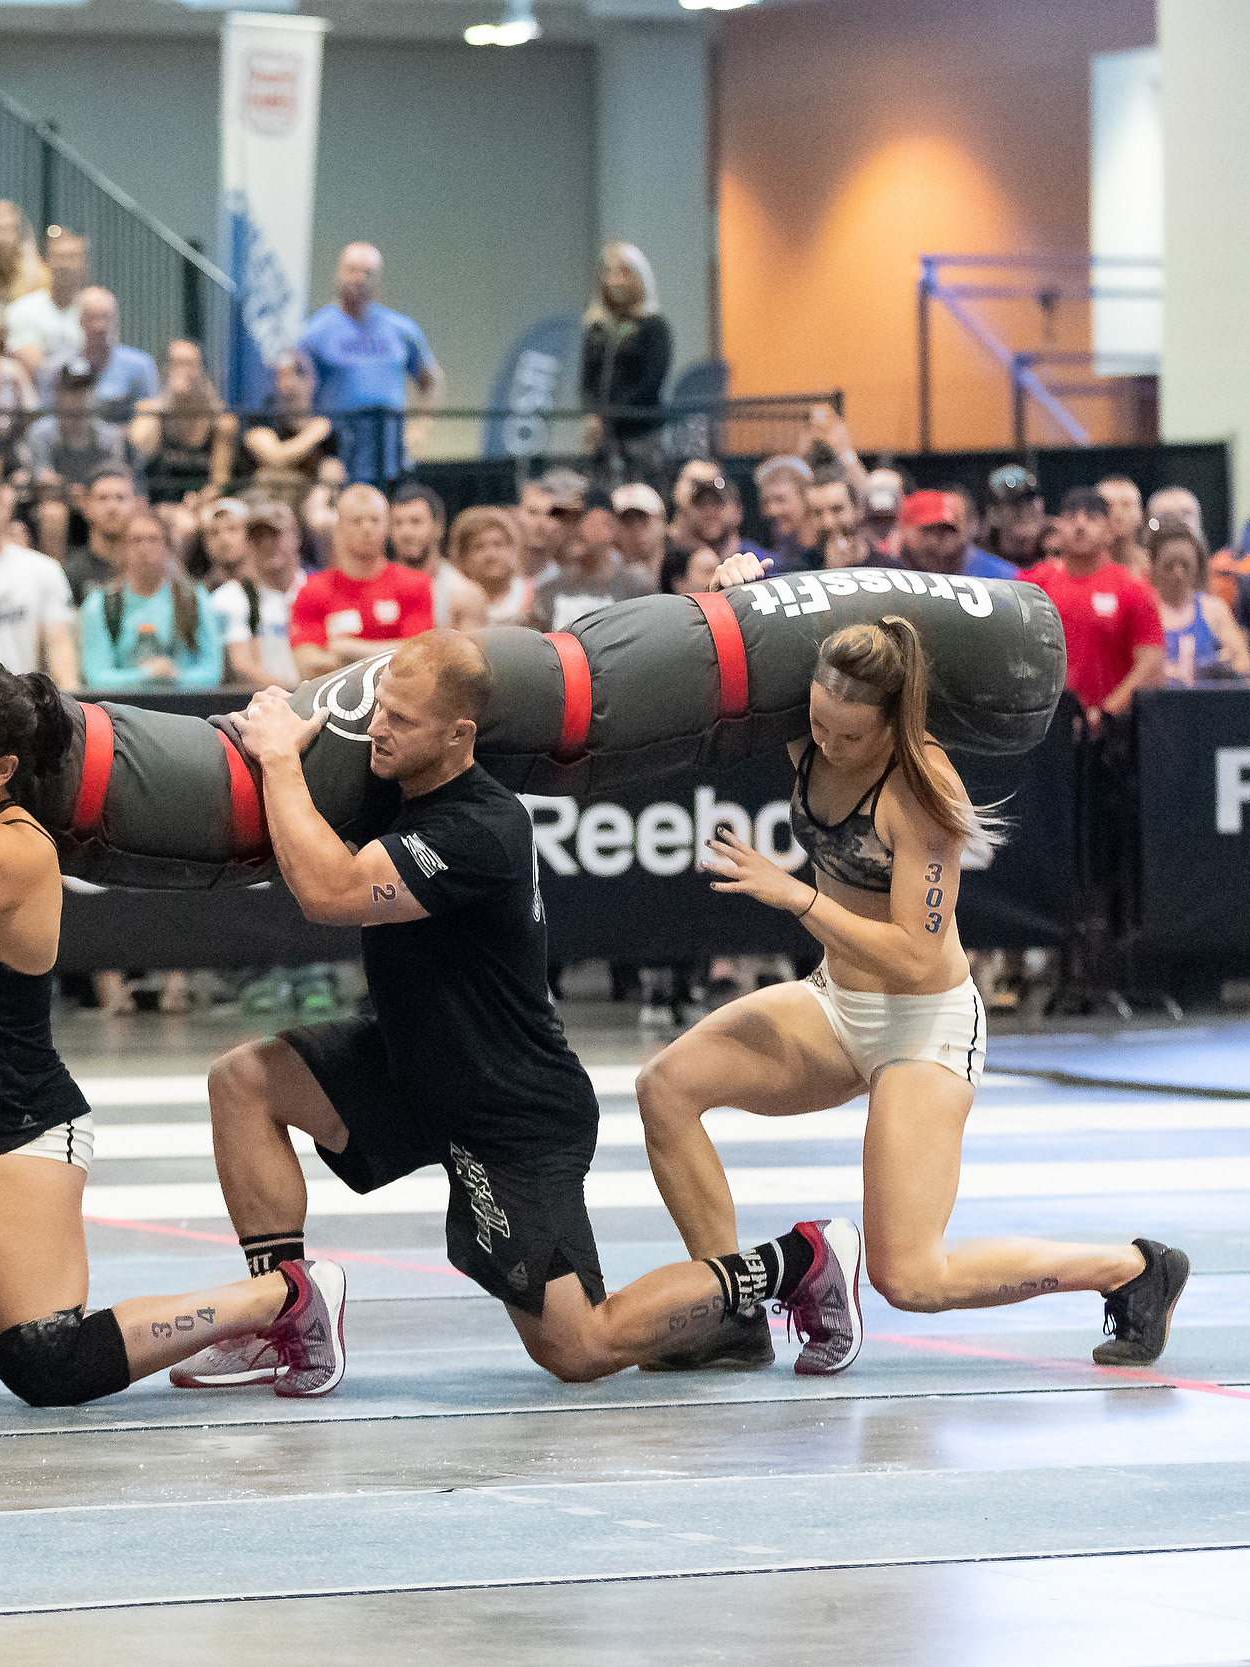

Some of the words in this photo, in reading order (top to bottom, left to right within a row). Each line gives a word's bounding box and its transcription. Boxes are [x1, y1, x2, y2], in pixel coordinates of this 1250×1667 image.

[740, 569, 994, 618] CrossFit
[516, 785, 999, 878] Reebo
[151, 1306, 217, 1340] 304
